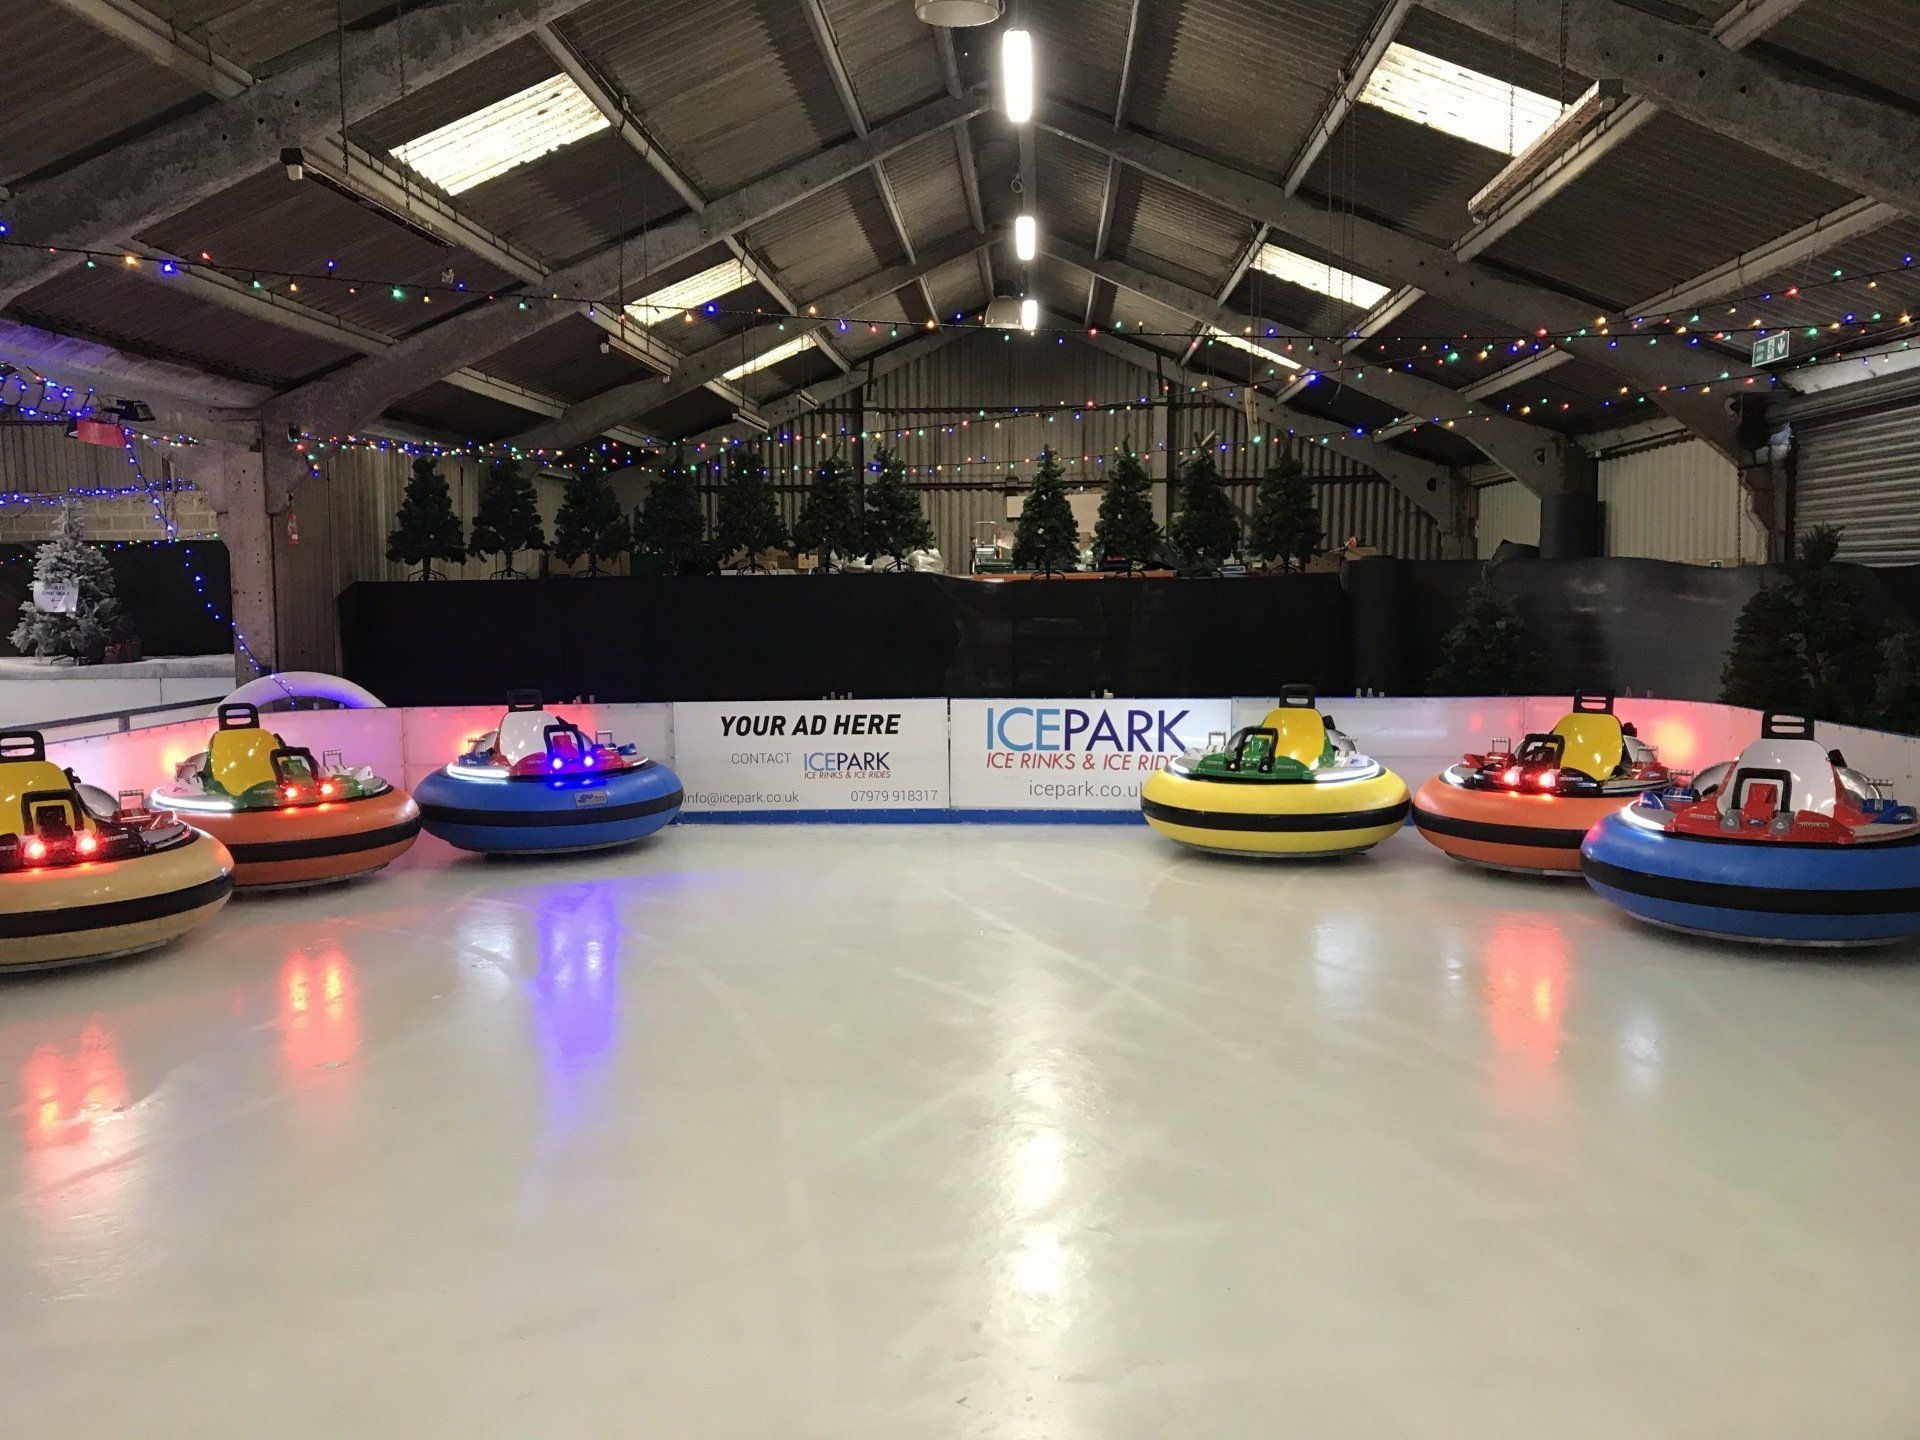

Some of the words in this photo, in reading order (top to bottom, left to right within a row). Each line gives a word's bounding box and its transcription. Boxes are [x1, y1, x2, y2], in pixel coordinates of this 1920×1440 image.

[720, 715, 786, 737] YOUR
[791, 715, 827, 736] AD
[833, 713, 901, 735] HERE
[986, 706, 1190, 753] ICEPARK
[731, 752, 792, 765] CONTACT
[804, 752, 891, 771] ICEPARK
[986, 753, 1015, 769] ICE
[1020, 753, 1076, 770] RINKS
[1082, 754, 1096, 770] &
[1103, 754, 1132, 771] ICE
[1138, 754, 1178, 771] RID
[804, 771, 817, 779] ICE
[819, 771, 843, 779] RINKS
[845, 771, 851, 779] &
[854, 771, 866, 779] ICE
[868, 770, 891, 779] RIDES
[851, 790, 889, 801] 07979
[892, 790, 938, 801] 918317
